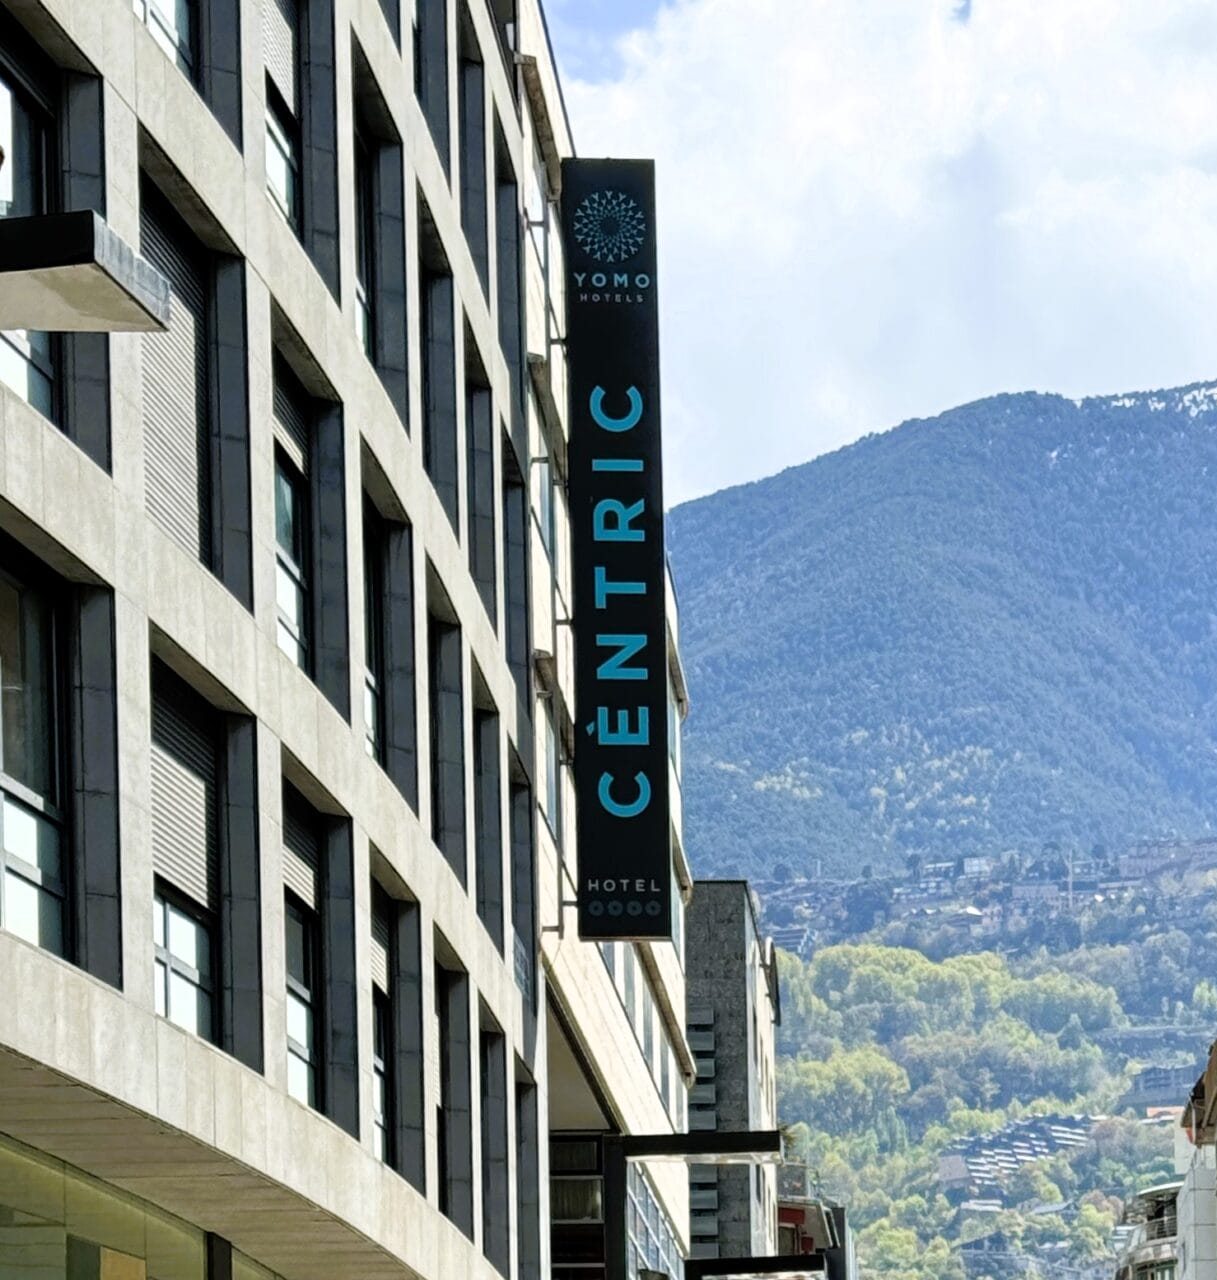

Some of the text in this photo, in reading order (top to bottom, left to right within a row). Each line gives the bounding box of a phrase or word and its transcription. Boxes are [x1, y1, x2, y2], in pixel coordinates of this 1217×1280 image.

[573, 272, 650, 289] YOMO
[580, 293, 644, 303] HOTELS
[586, 384, 652, 818] CÈNTRIC
[588, 879, 661, 892] HOTEL
